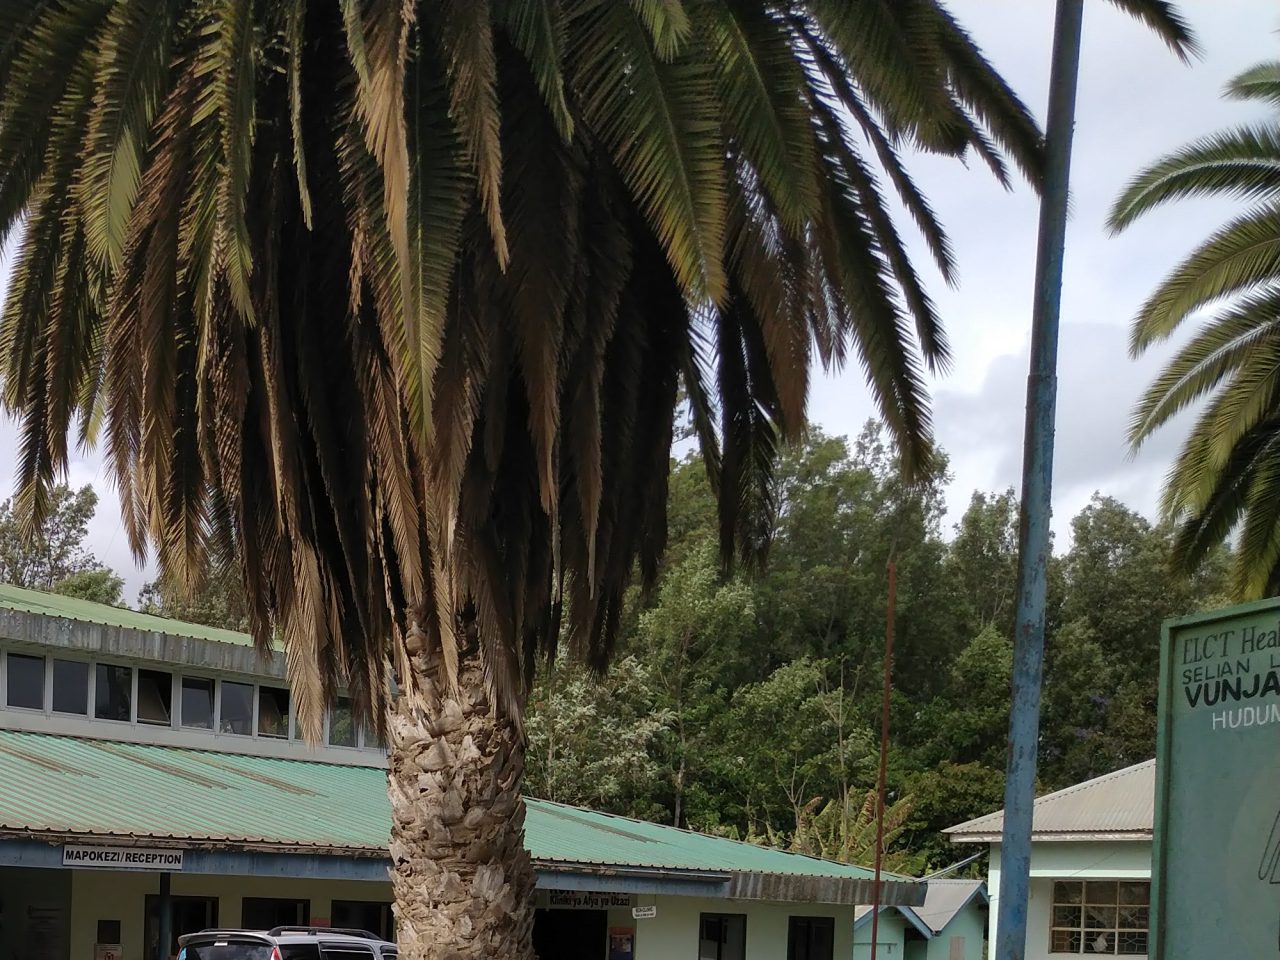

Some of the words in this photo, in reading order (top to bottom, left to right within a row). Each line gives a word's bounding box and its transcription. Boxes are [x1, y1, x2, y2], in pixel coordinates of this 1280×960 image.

[1182, 630, 1235, 665] ELCT
[1182, 658, 1250, 685] SELIAN
[1184, 671, 1280, 708] VUNJA
[65, 850, 182, 865] MAPOKEZI/RECEPTION
